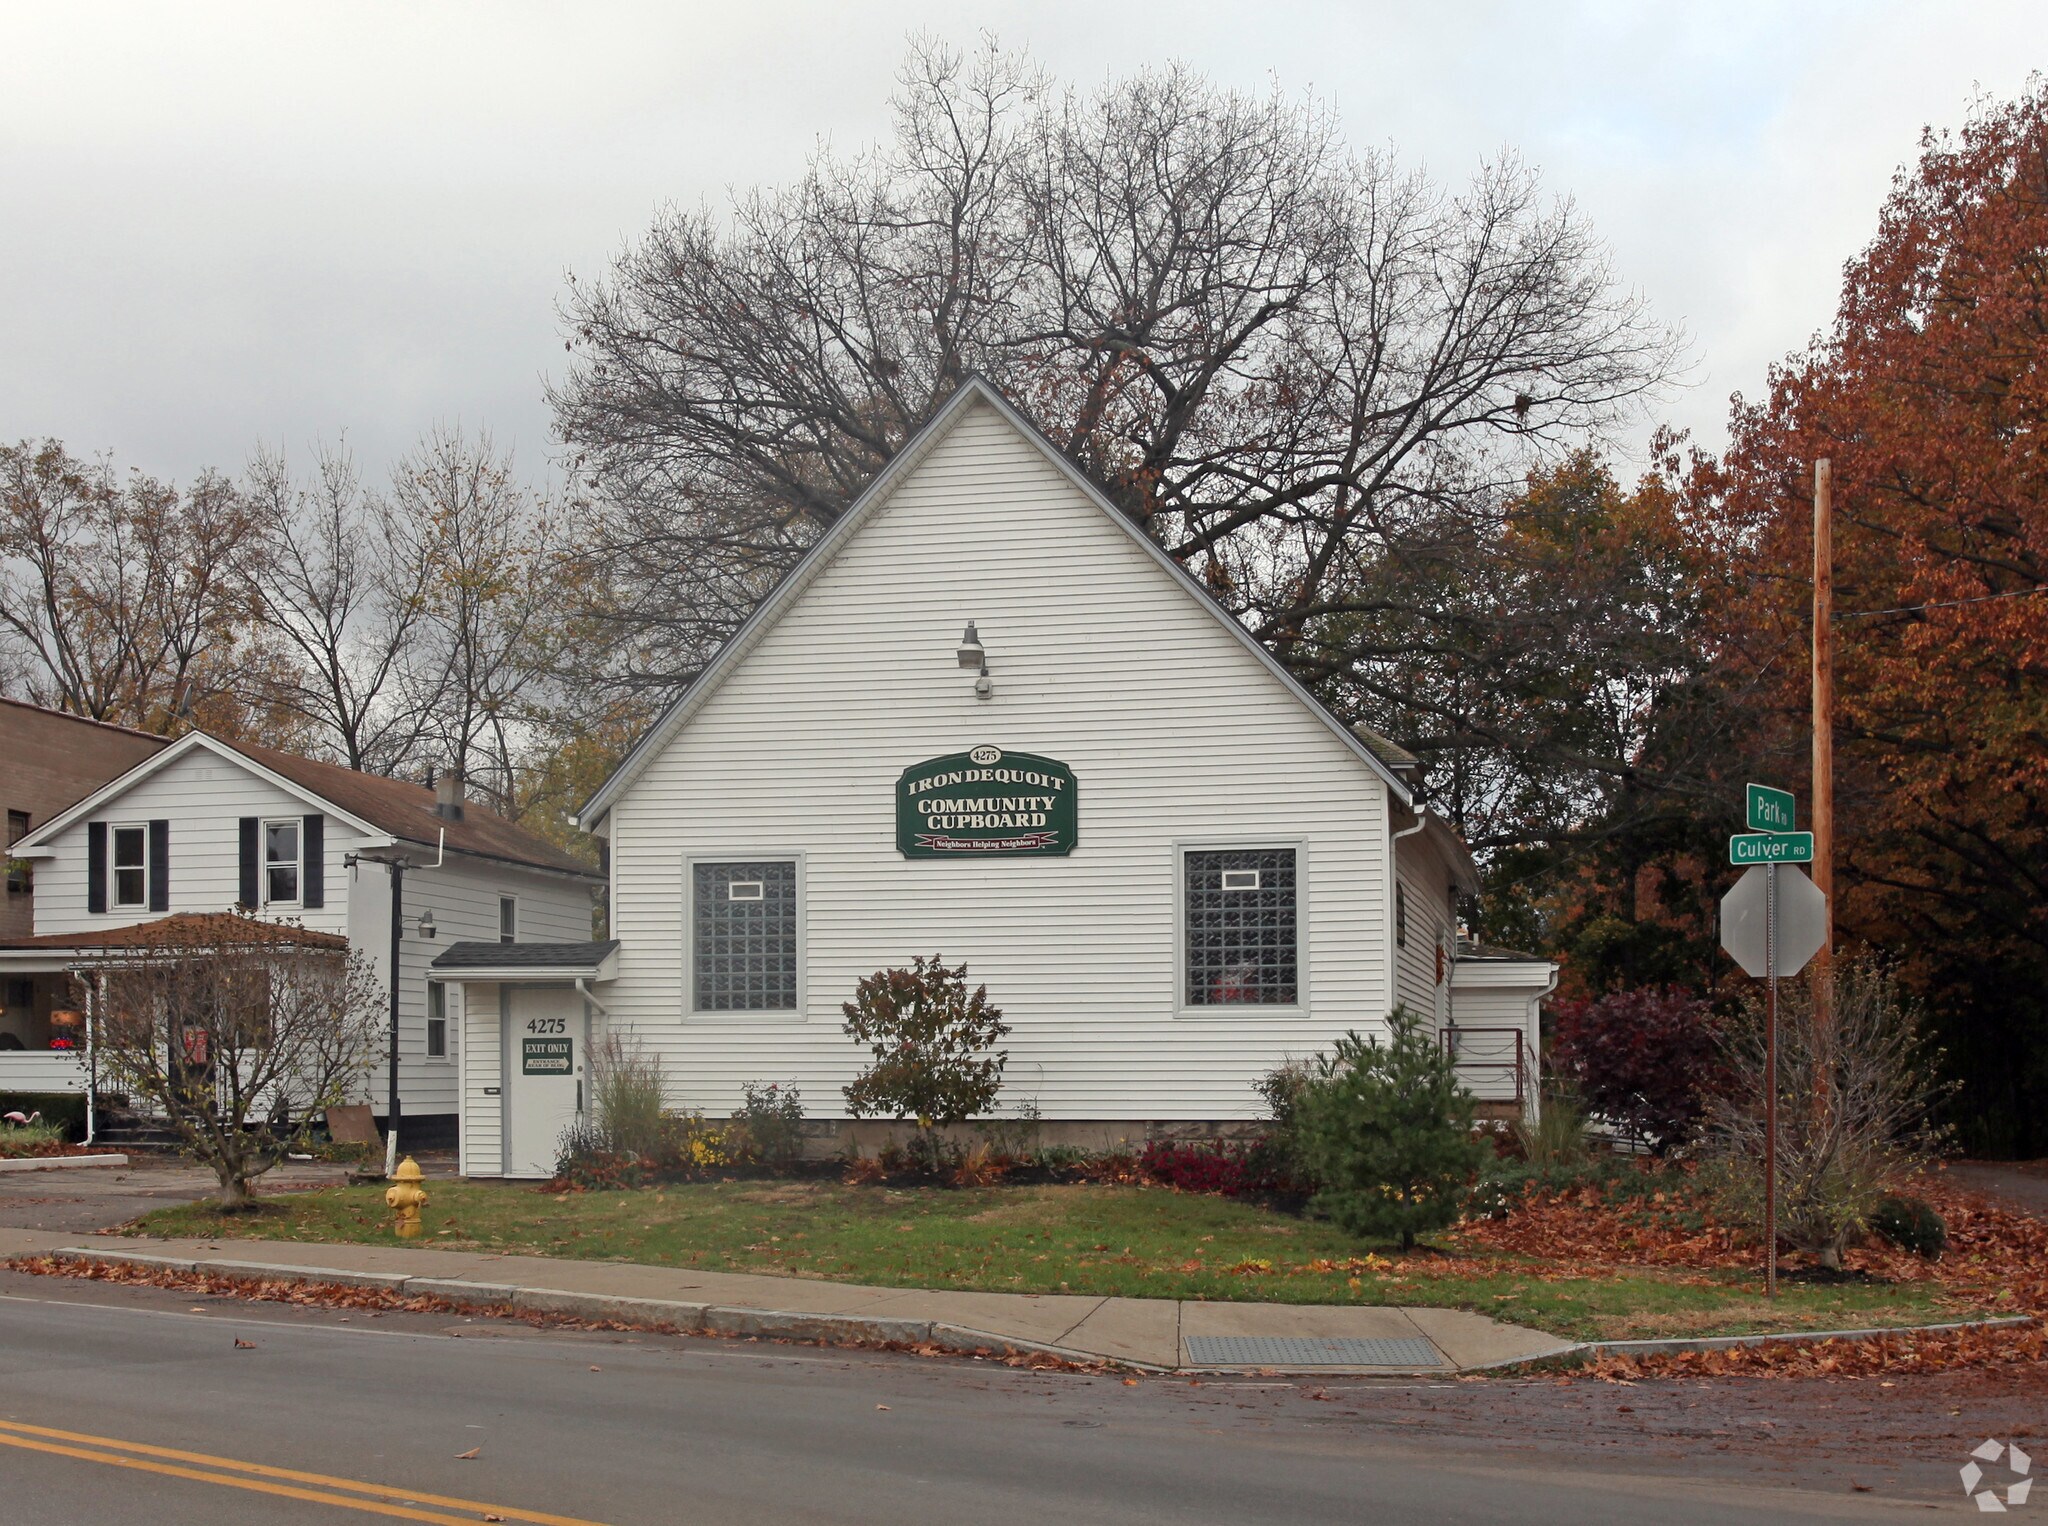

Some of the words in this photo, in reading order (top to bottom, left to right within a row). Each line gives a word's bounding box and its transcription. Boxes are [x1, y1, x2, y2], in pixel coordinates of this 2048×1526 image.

[973, 750, 997, 761] 4275
[908, 768, 1064, 795] IRONDEQUOIT
[918, 796, 1056, 814] COMMUNITY
[1757, 796, 1781, 824] Park
[927, 813, 1046, 830] CUPBOARD
[936, 840, 971, 849] Neighbors
[972, 841, 1000, 849] Helping
[1001, 839, 1036, 848] Neighbors
[1737, 841, 1789, 858] Culver
[1793, 847, 1805, 855] RD
[527, 1018, 566, 1034] 4275
[526, 1044, 546, 1053] EXIT
[547, 1044, 569, 1053] ONLY
